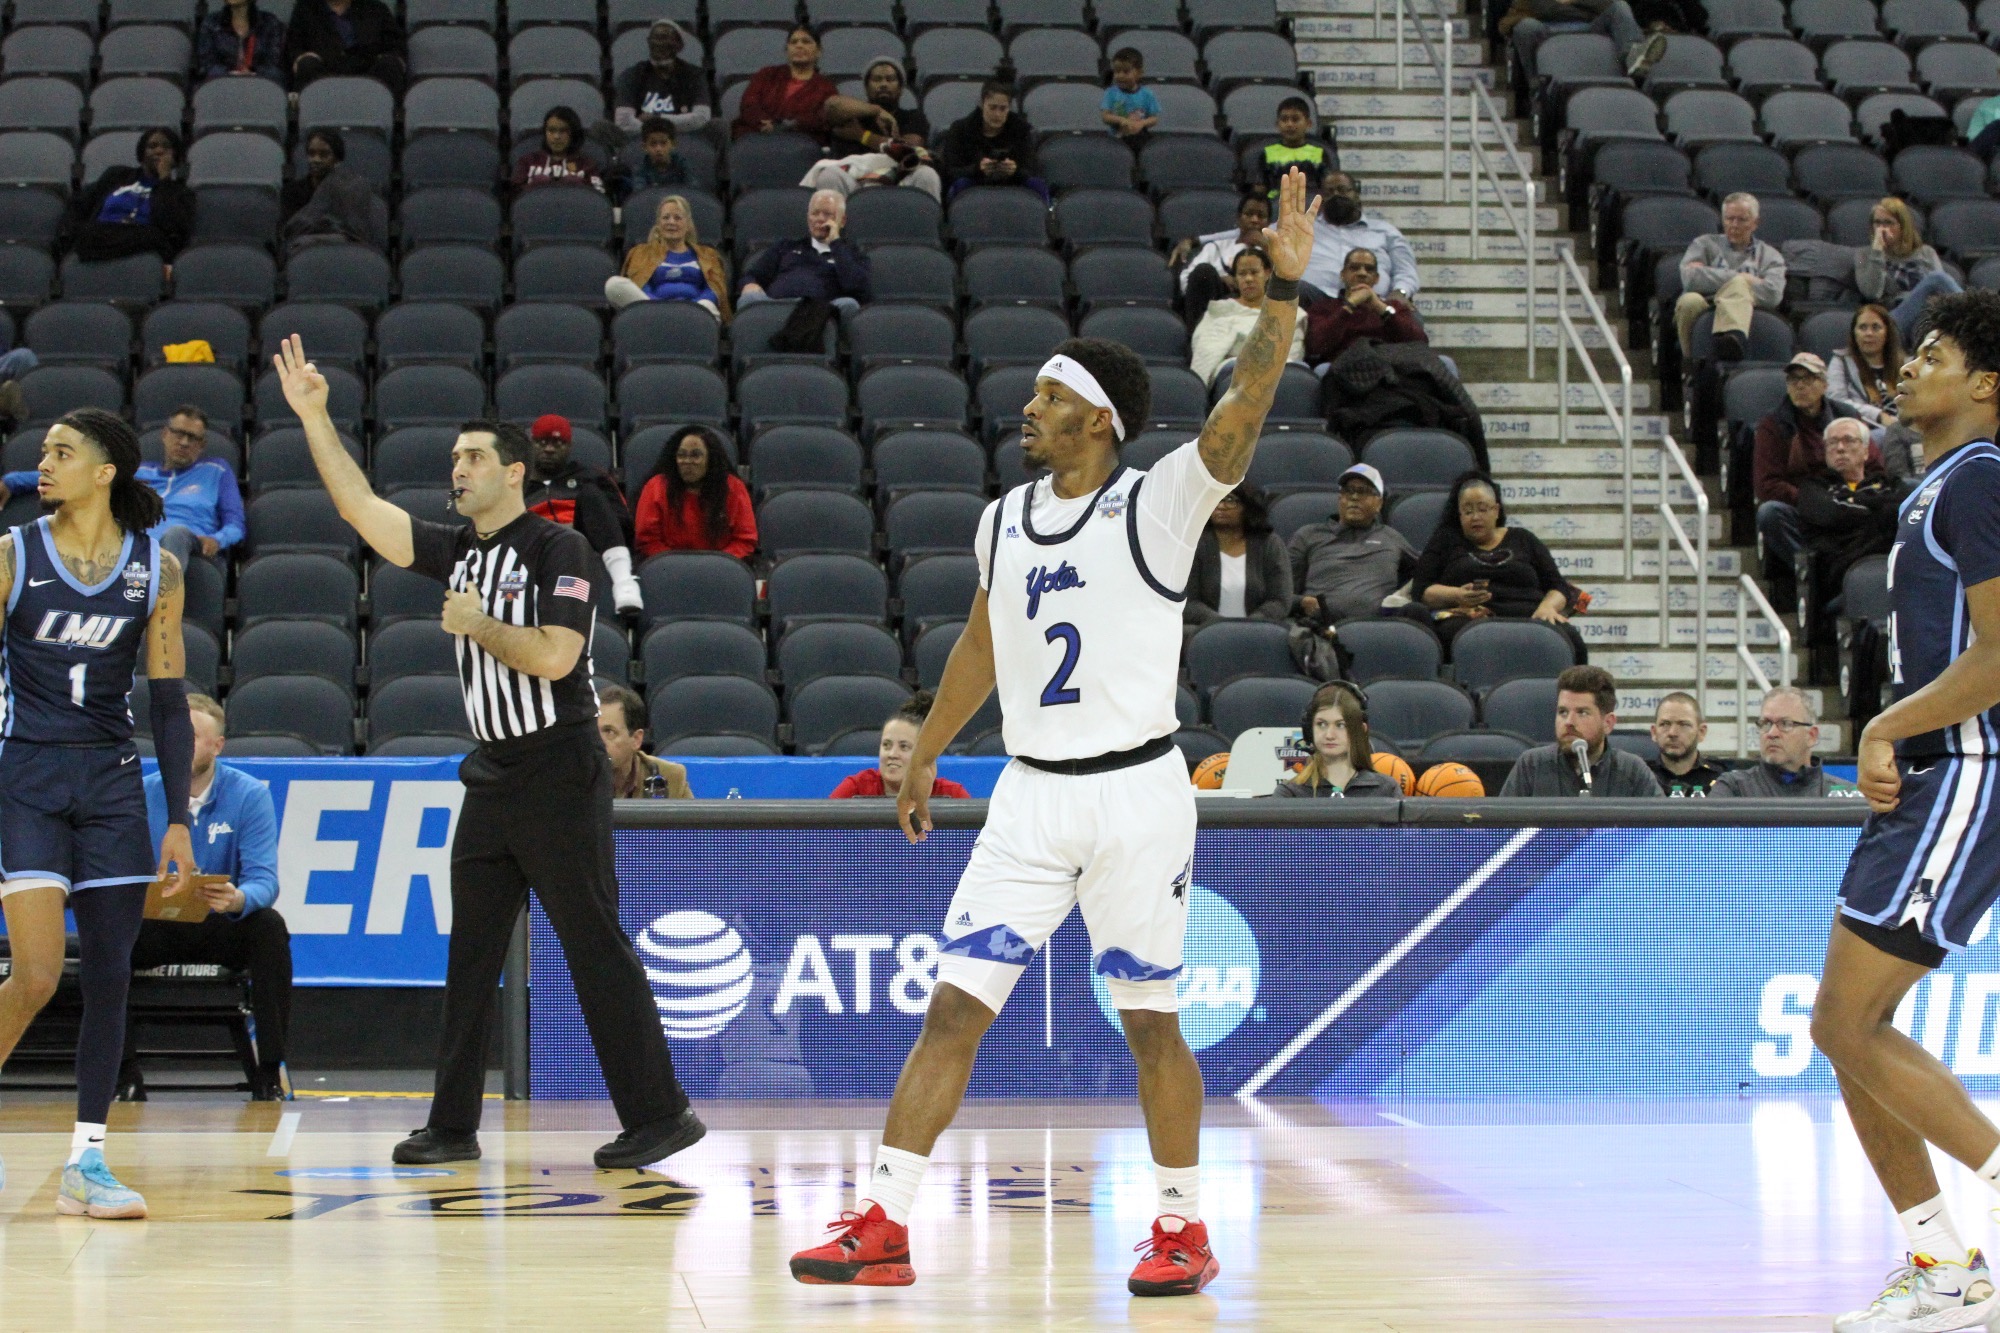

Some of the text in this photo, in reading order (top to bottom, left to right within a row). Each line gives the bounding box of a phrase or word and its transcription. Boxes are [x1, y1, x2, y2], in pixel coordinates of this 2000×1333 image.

[1519, 486, 1560, 498] 730-4112
[126, 589, 146, 599] SAC
[32, 609, 136, 650] LMU
[1584, 625, 1628, 637] 730-4112
[1040, 622, 1081, 707] 2
[68, 662, 88, 708] 1
[1622, 697, 1663, 709] 730-411
[167, 964, 179, 977] IT
[181, 964, 219, 977] YOURS
